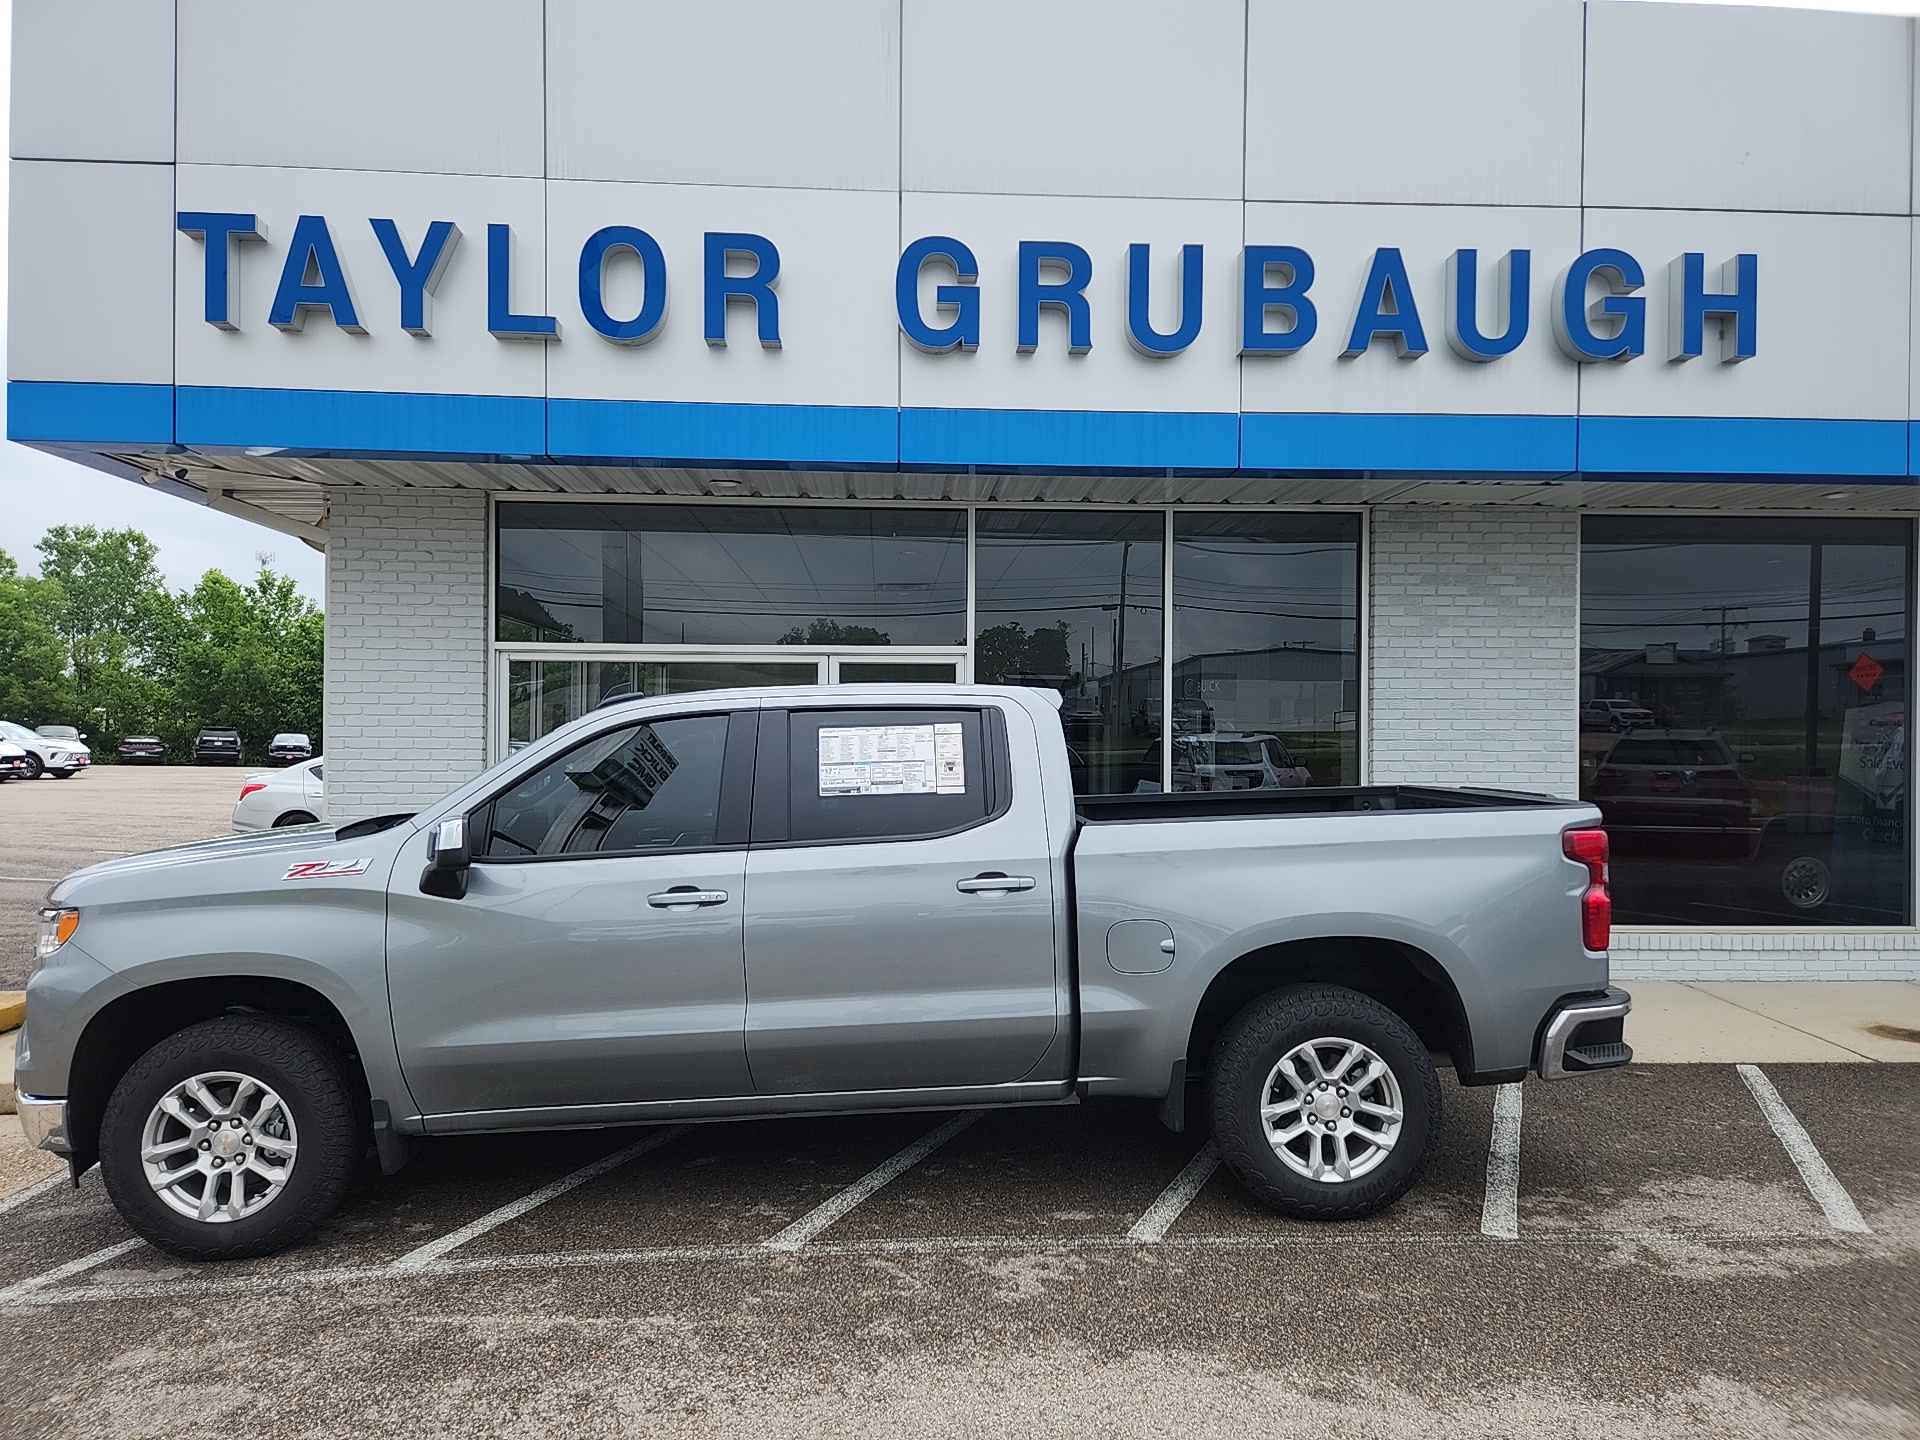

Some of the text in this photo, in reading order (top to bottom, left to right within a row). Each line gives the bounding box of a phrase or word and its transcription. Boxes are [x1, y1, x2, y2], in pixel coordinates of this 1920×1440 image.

[177, 211, 1757, 363] TAYLOR GRUBAUGH
[1859, 756, 1904, 770] Sale Eve
[1850, 815, 1902, 828] Auto financi
[281, 857, 375, 881] Z71
